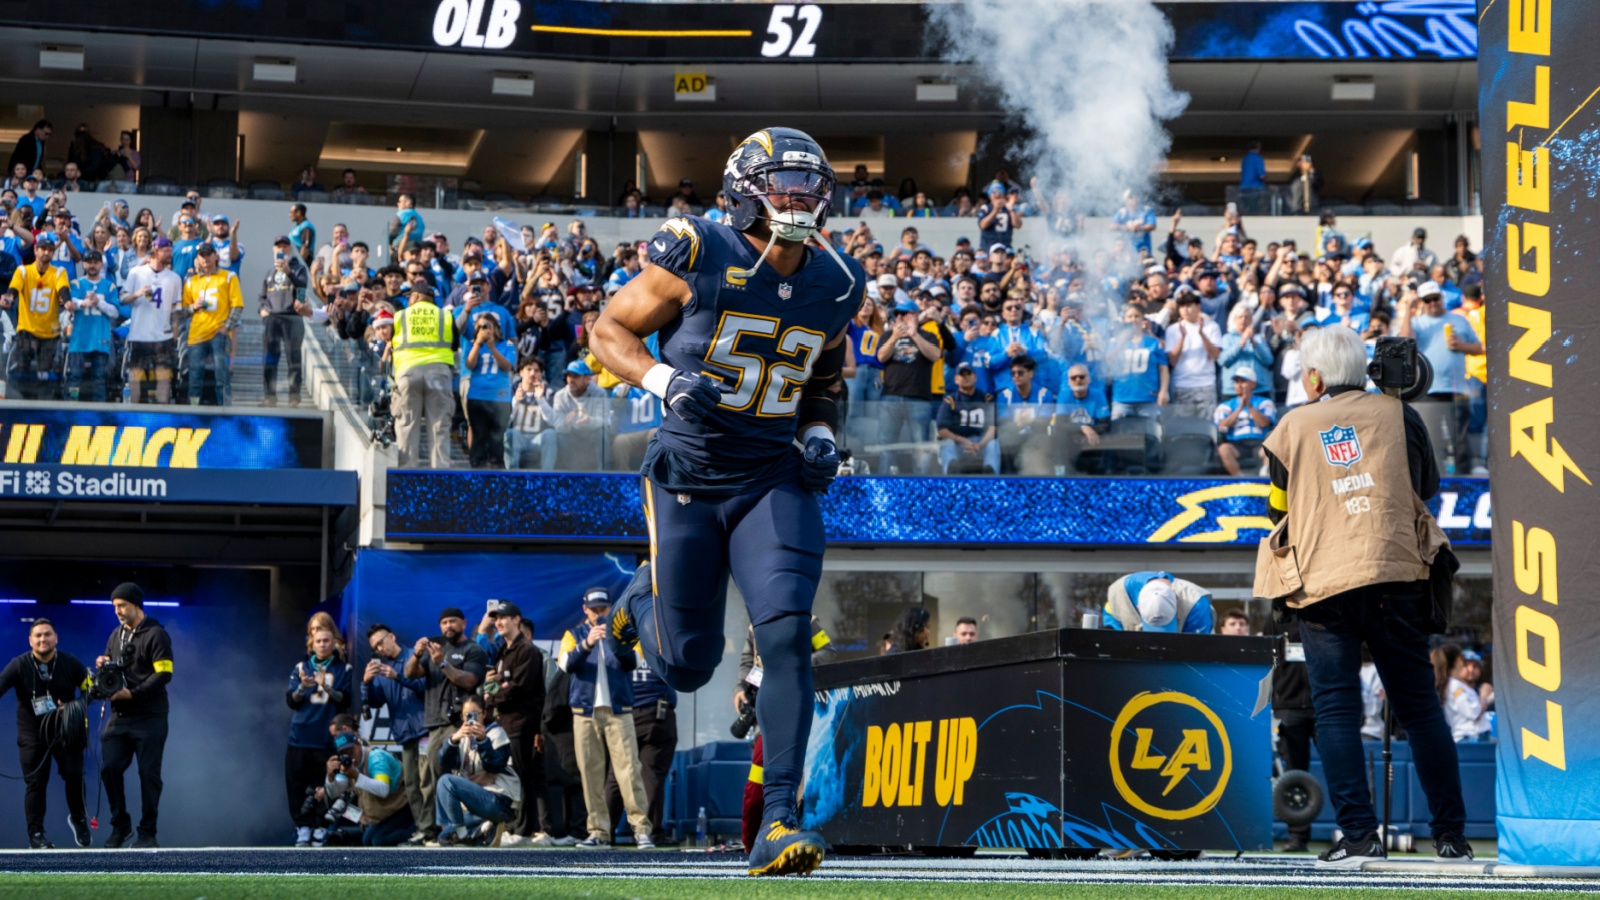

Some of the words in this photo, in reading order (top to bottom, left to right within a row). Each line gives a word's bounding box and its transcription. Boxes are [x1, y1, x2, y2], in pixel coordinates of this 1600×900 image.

[432, 0, 522, 49] OLB
[761, 4, 823, 58] 52
[676, 76, 707, 94] AD
[995, 213, 1009, 233] 3
[29, 288, 52, 313] 15
[411, 308, 435, 316] APEX
[411, 327, 435, 336] GROUP
[480, 352, 499, 375] 11
[701, 310, 827, 417] 52
[1123, 348, 1150, 374] 10
[631, 392, 655, 424] 10
[60, 425, 211, 469] MACK
[1328, 441, 1358, 462] NFL
[57, 471, 167, 497] Stadium
[1331, 472, 1375, 495] MEDIA
[1344, 496, 1371, 516] 183
[1511, 520, 1567, 771] LOS
[862, 720, 932, 808] BOLT
[934, 716, 978, 807] UP
[1130, 727, 1212, 797] LA
